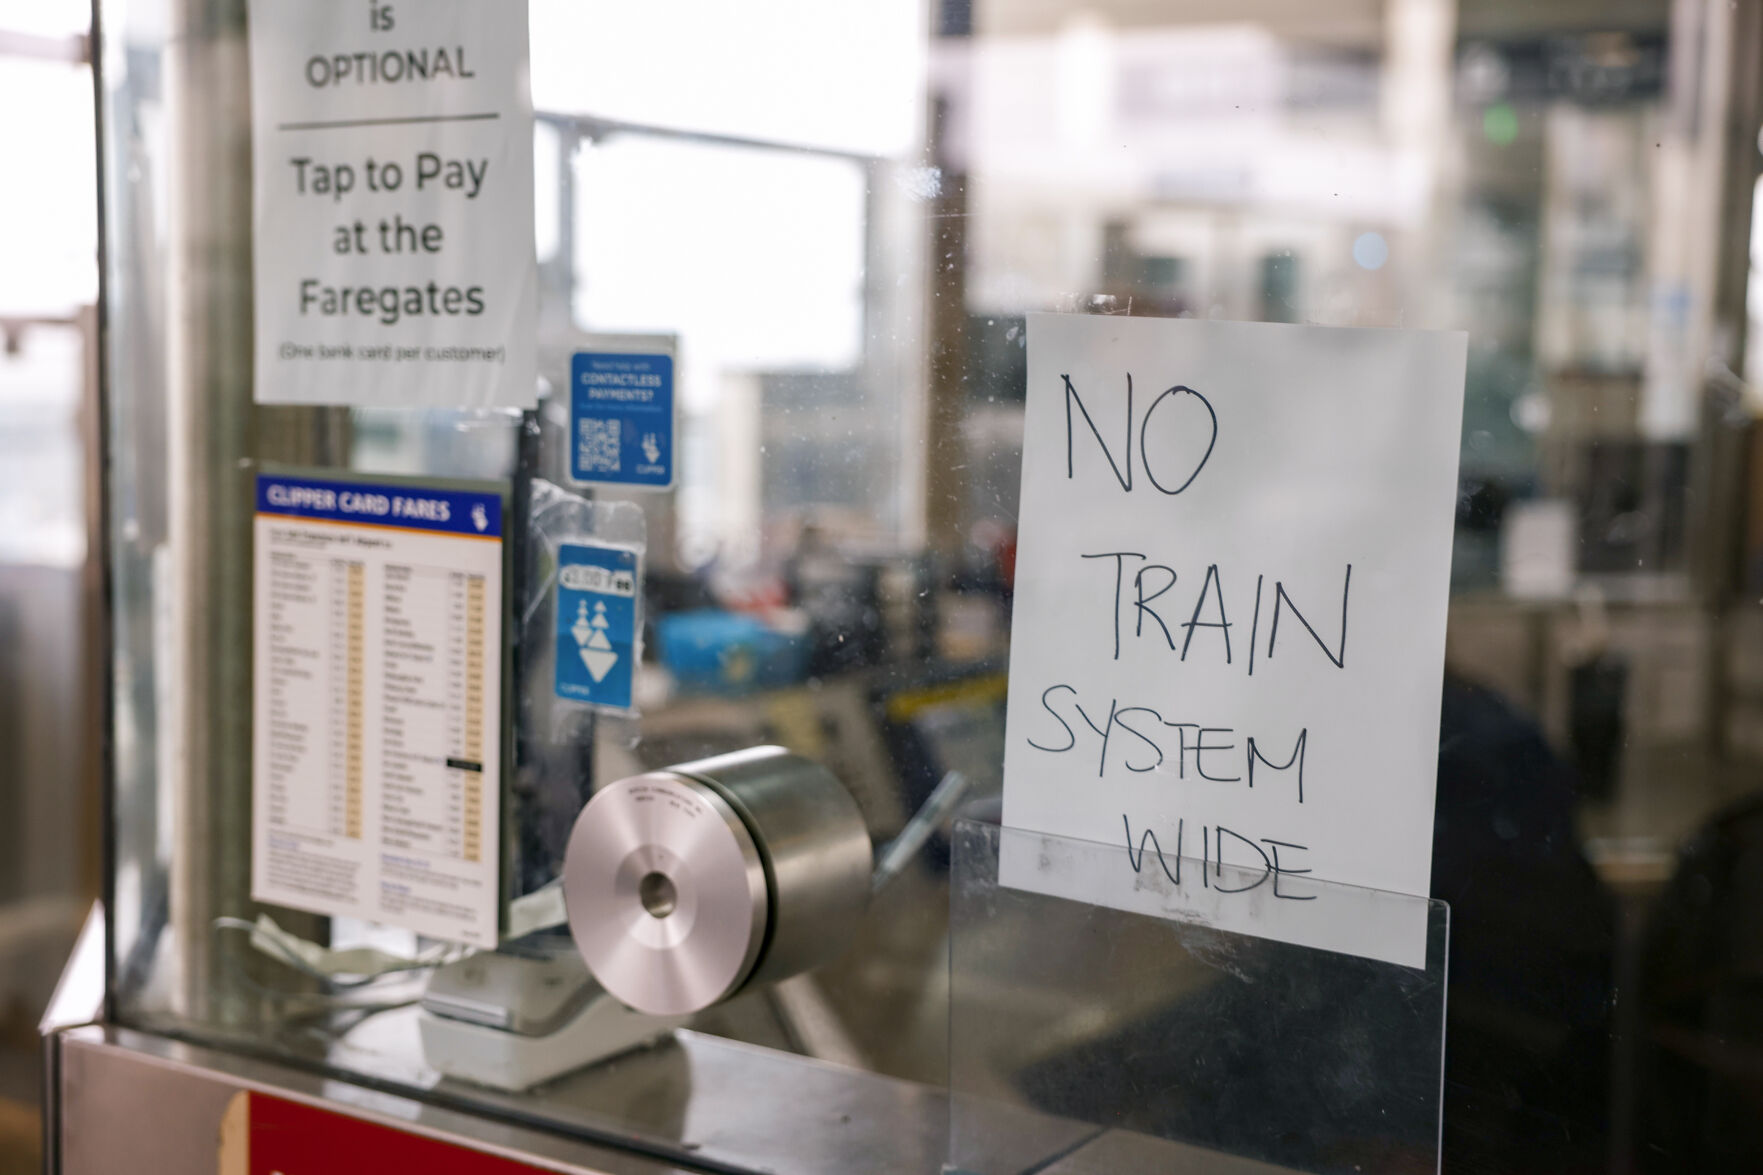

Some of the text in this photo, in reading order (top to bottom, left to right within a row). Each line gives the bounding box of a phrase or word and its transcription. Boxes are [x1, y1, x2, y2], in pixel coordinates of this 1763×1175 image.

[369, 0, 395, 32] is
[305, 47, 475, 88] OPTIONAL
[290, 153, 488, 199] Tap to Pay
[333, 215, 444, 255] at the
[299, 280, 485, 324] Faregates
[318, 342, 353, 361] bank
[359, 342, 394, 362] card
[396, 346, 421, 365] per
[581, 372, 662, 388] CONTACTLESS
[588, 386, 655, 402] PAYMENTS?
[1061, 372, 1217, 495] NO
[266, 484, 451, 522] CLIPPER CARD FARES
[1081, 552, 1351, 675] TRAIN
[1027, 685, 1307, 803] SYSTEM
[1122, 814, 1318, 901] WIDE
